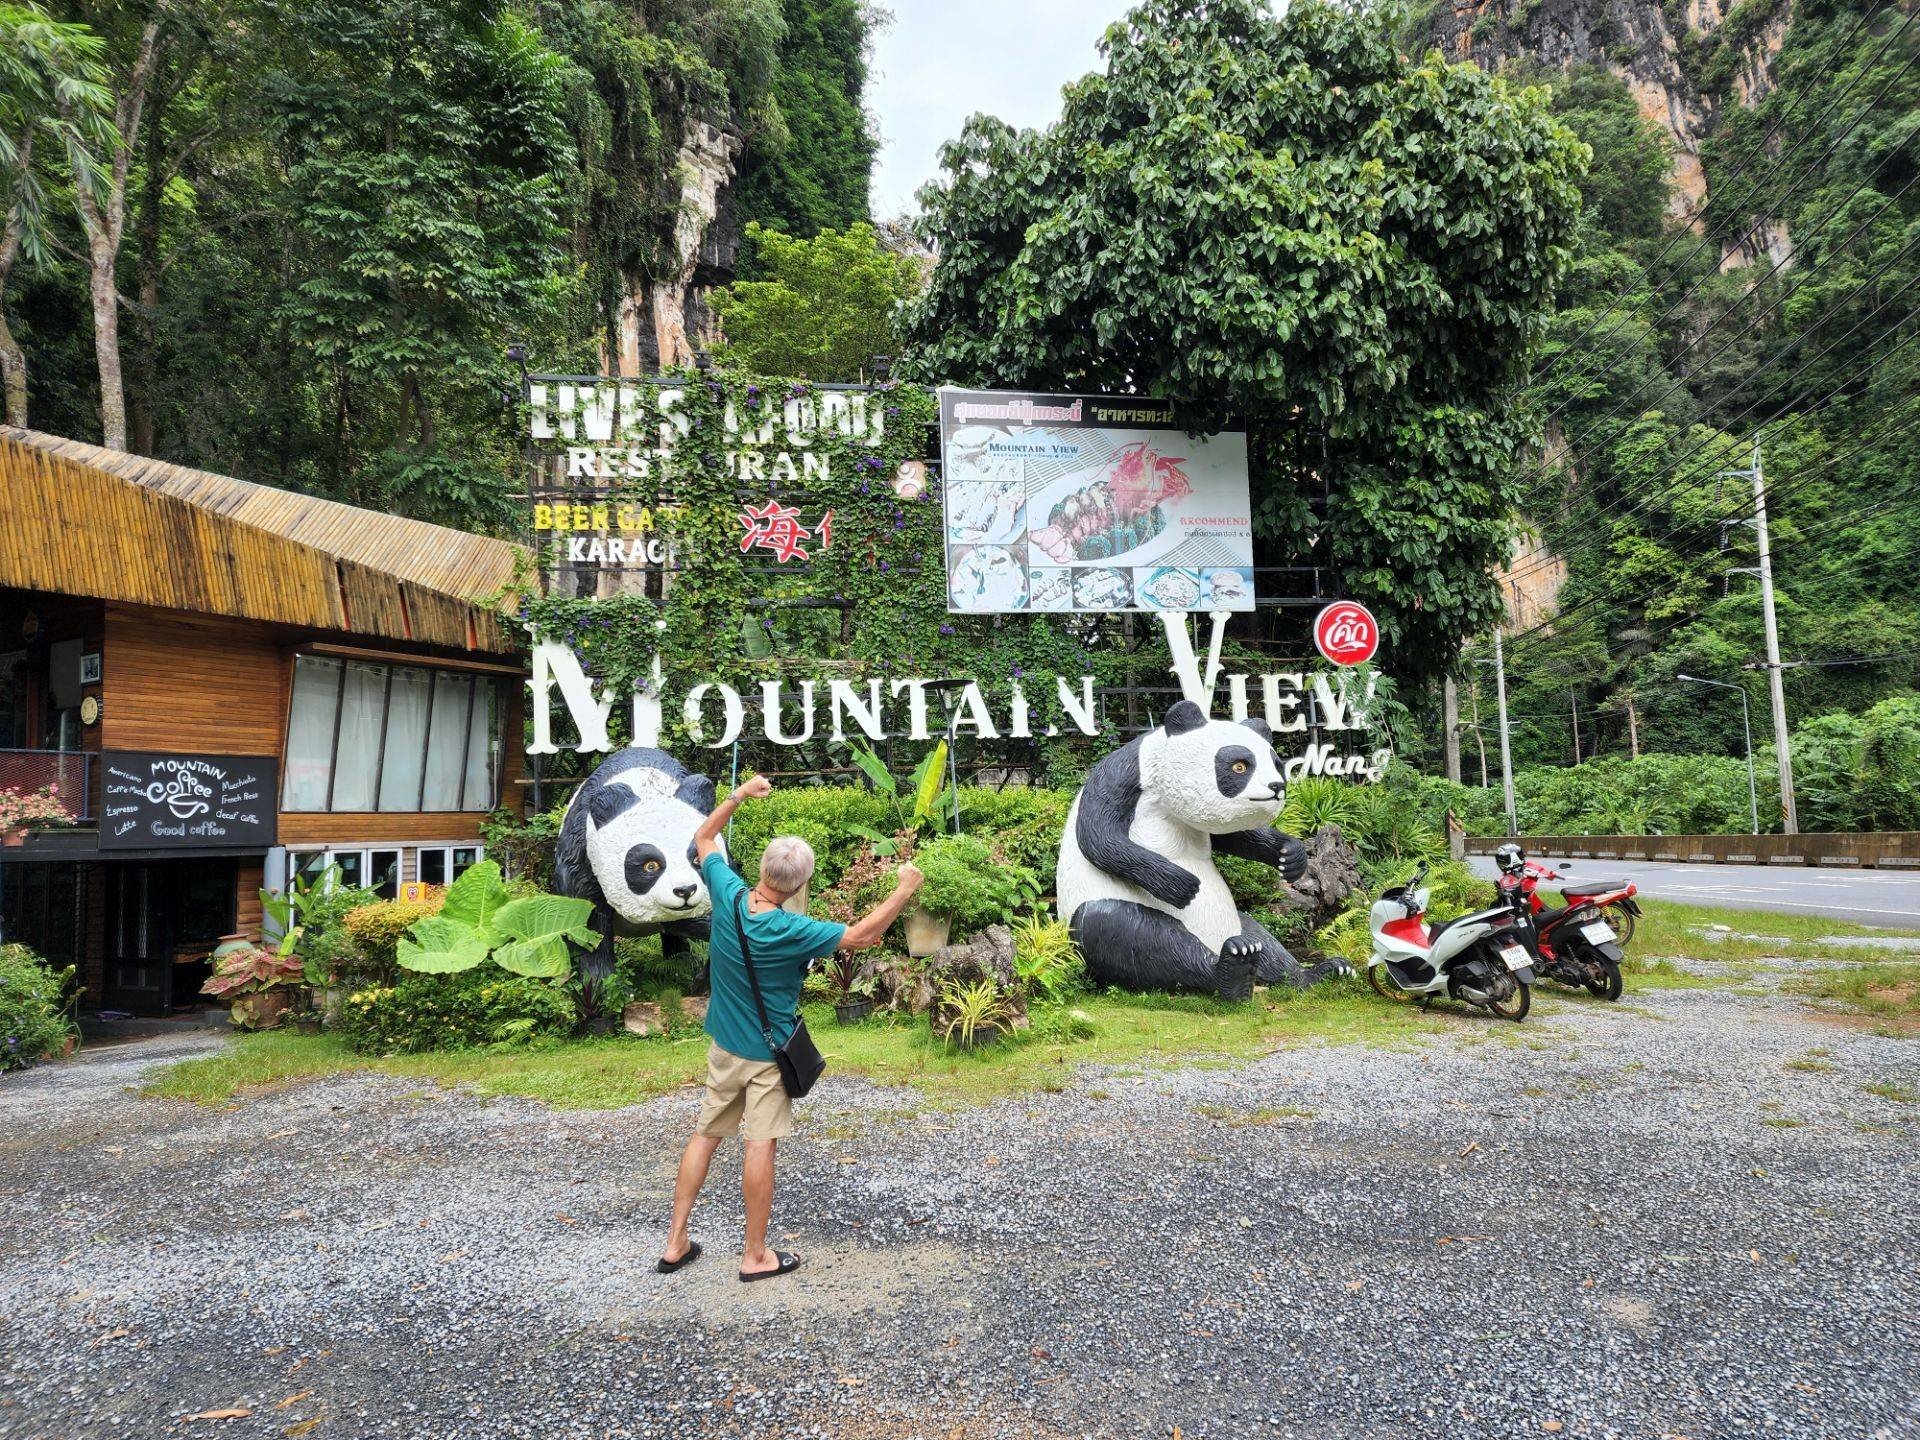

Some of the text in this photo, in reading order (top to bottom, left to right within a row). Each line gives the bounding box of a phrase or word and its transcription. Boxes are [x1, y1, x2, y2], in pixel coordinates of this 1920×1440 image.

[533, 504, 611, 532] BEER
[150, 760, 227, 780] MOUNTAIN
[150, 820, 186, 836] Good
